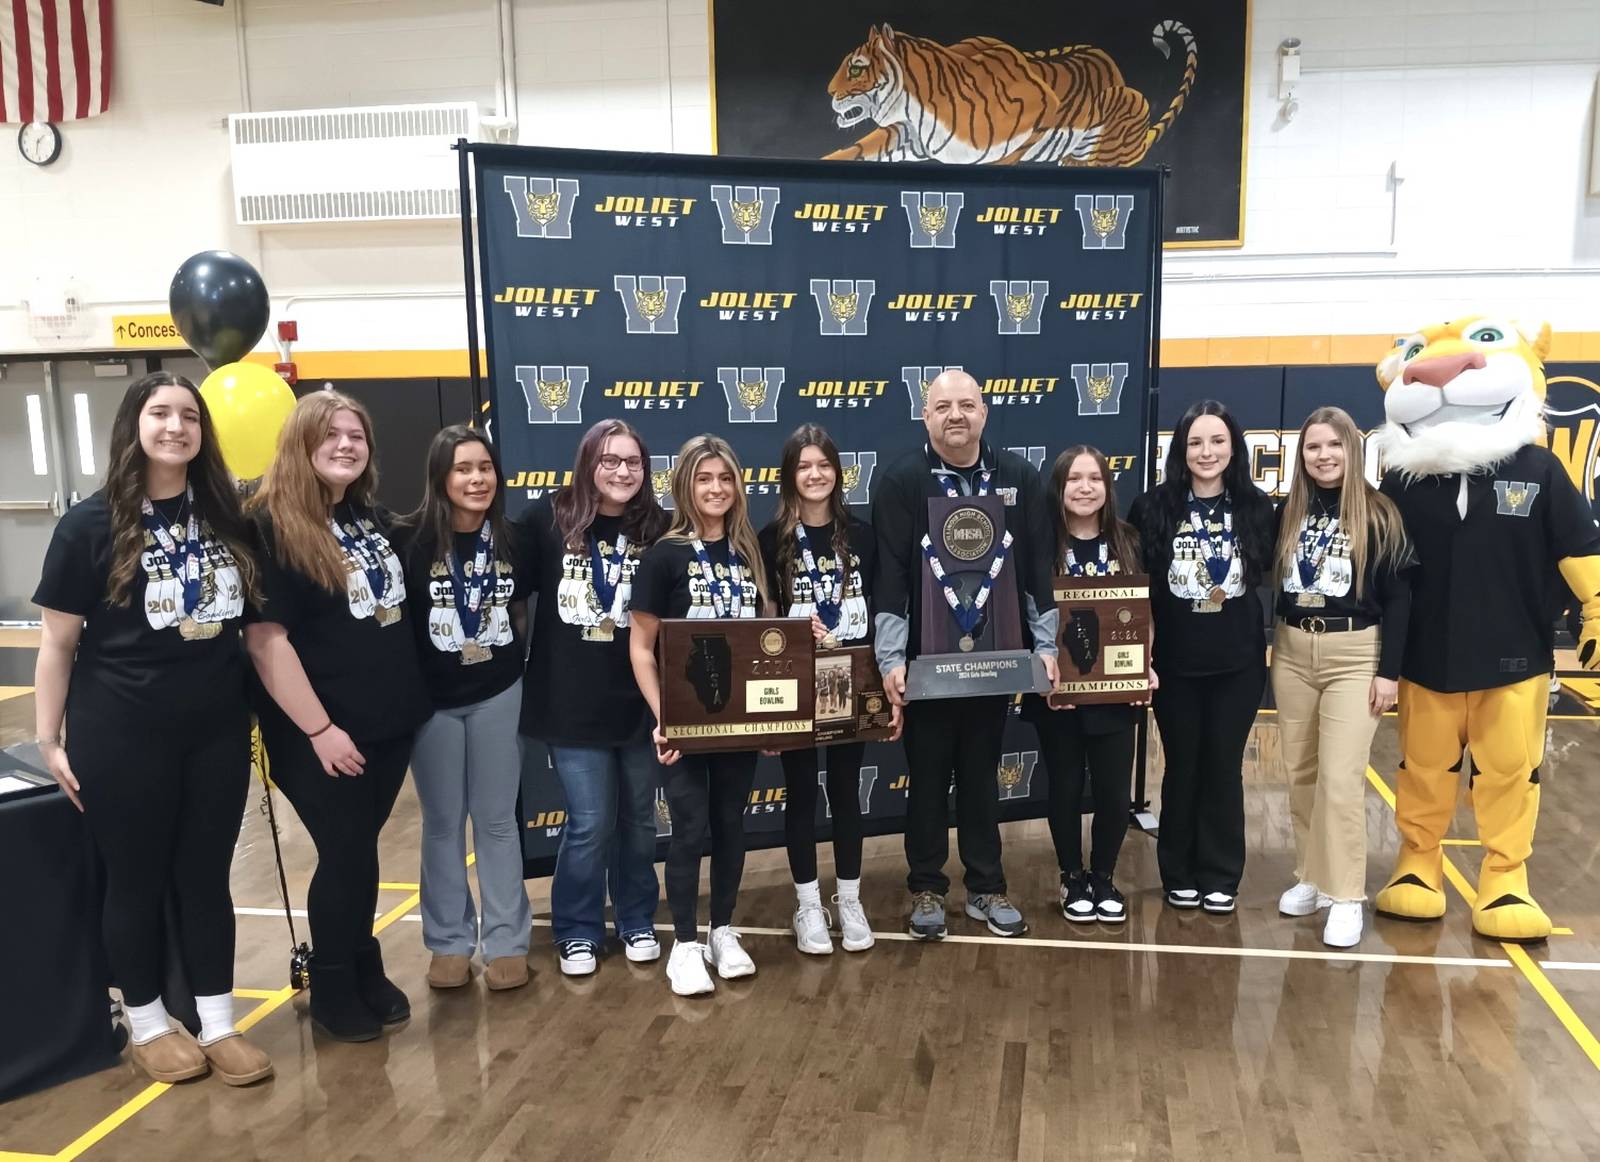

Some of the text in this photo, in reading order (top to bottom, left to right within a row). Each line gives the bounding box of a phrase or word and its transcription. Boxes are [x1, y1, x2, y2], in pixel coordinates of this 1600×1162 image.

[595, 196, 697, 215] JOLIET
[794, 203, 888, 221] JOLIET
[615, 216, 681, 228] WEST
[976, 207, 1063, 224] JOLIET
[812, 222, 871, 233] WEST
[993, 224, 1047, 236] WEST
[494, 287, 600, 305] JOLIET
[700, 292, 798, 309] JOLIET
[888, 294, 978, 310] JOLIET
[1059, 293, 1143, 309] JOLIET
[515, 306, 582, 318] WEST
[719, 310, 780, 322] WEST
[905, 311, 961, 322] WEST
[1075, 310, 1128, 321] WEST
[128, 322, 183, 338] Conces
[604, 381, 704, 398] JOLIET
[799, 380, 889, 396] JOLIET
[980, 378, 1059, 394] JOLIET
[624, 399, 687, 410] WEST
[815, 398, 872, 408] WEST
[992, 394, 1044, 405] WEST
[506, 471, 573, 488] JOLI
[745, 484, 781, 495] EST
[1176, 541, 1200, 549] JOLI
[566, 559, 592, 568] JOLI
[1231, 573, 1240, 584] 2
[350, 587, 369, 604] 20
[560, 593, 577, 609] 20
[1063, 588, 1138, 600] REGIONAL
[148, 598, 176, 614] 20
[850, 612, 866, 626] 24
[430, 620, 509, 637] 20 2
[935, 660, 1018, 674] STATE CHAMPIONS
[763, 687, 780, 696] GIRLS
[759, 696, 785, 706] BOWLING
[673, 721, 807, 737] SECTIONAL CHAMPIONS
[744, 803, 786, 815] EST
